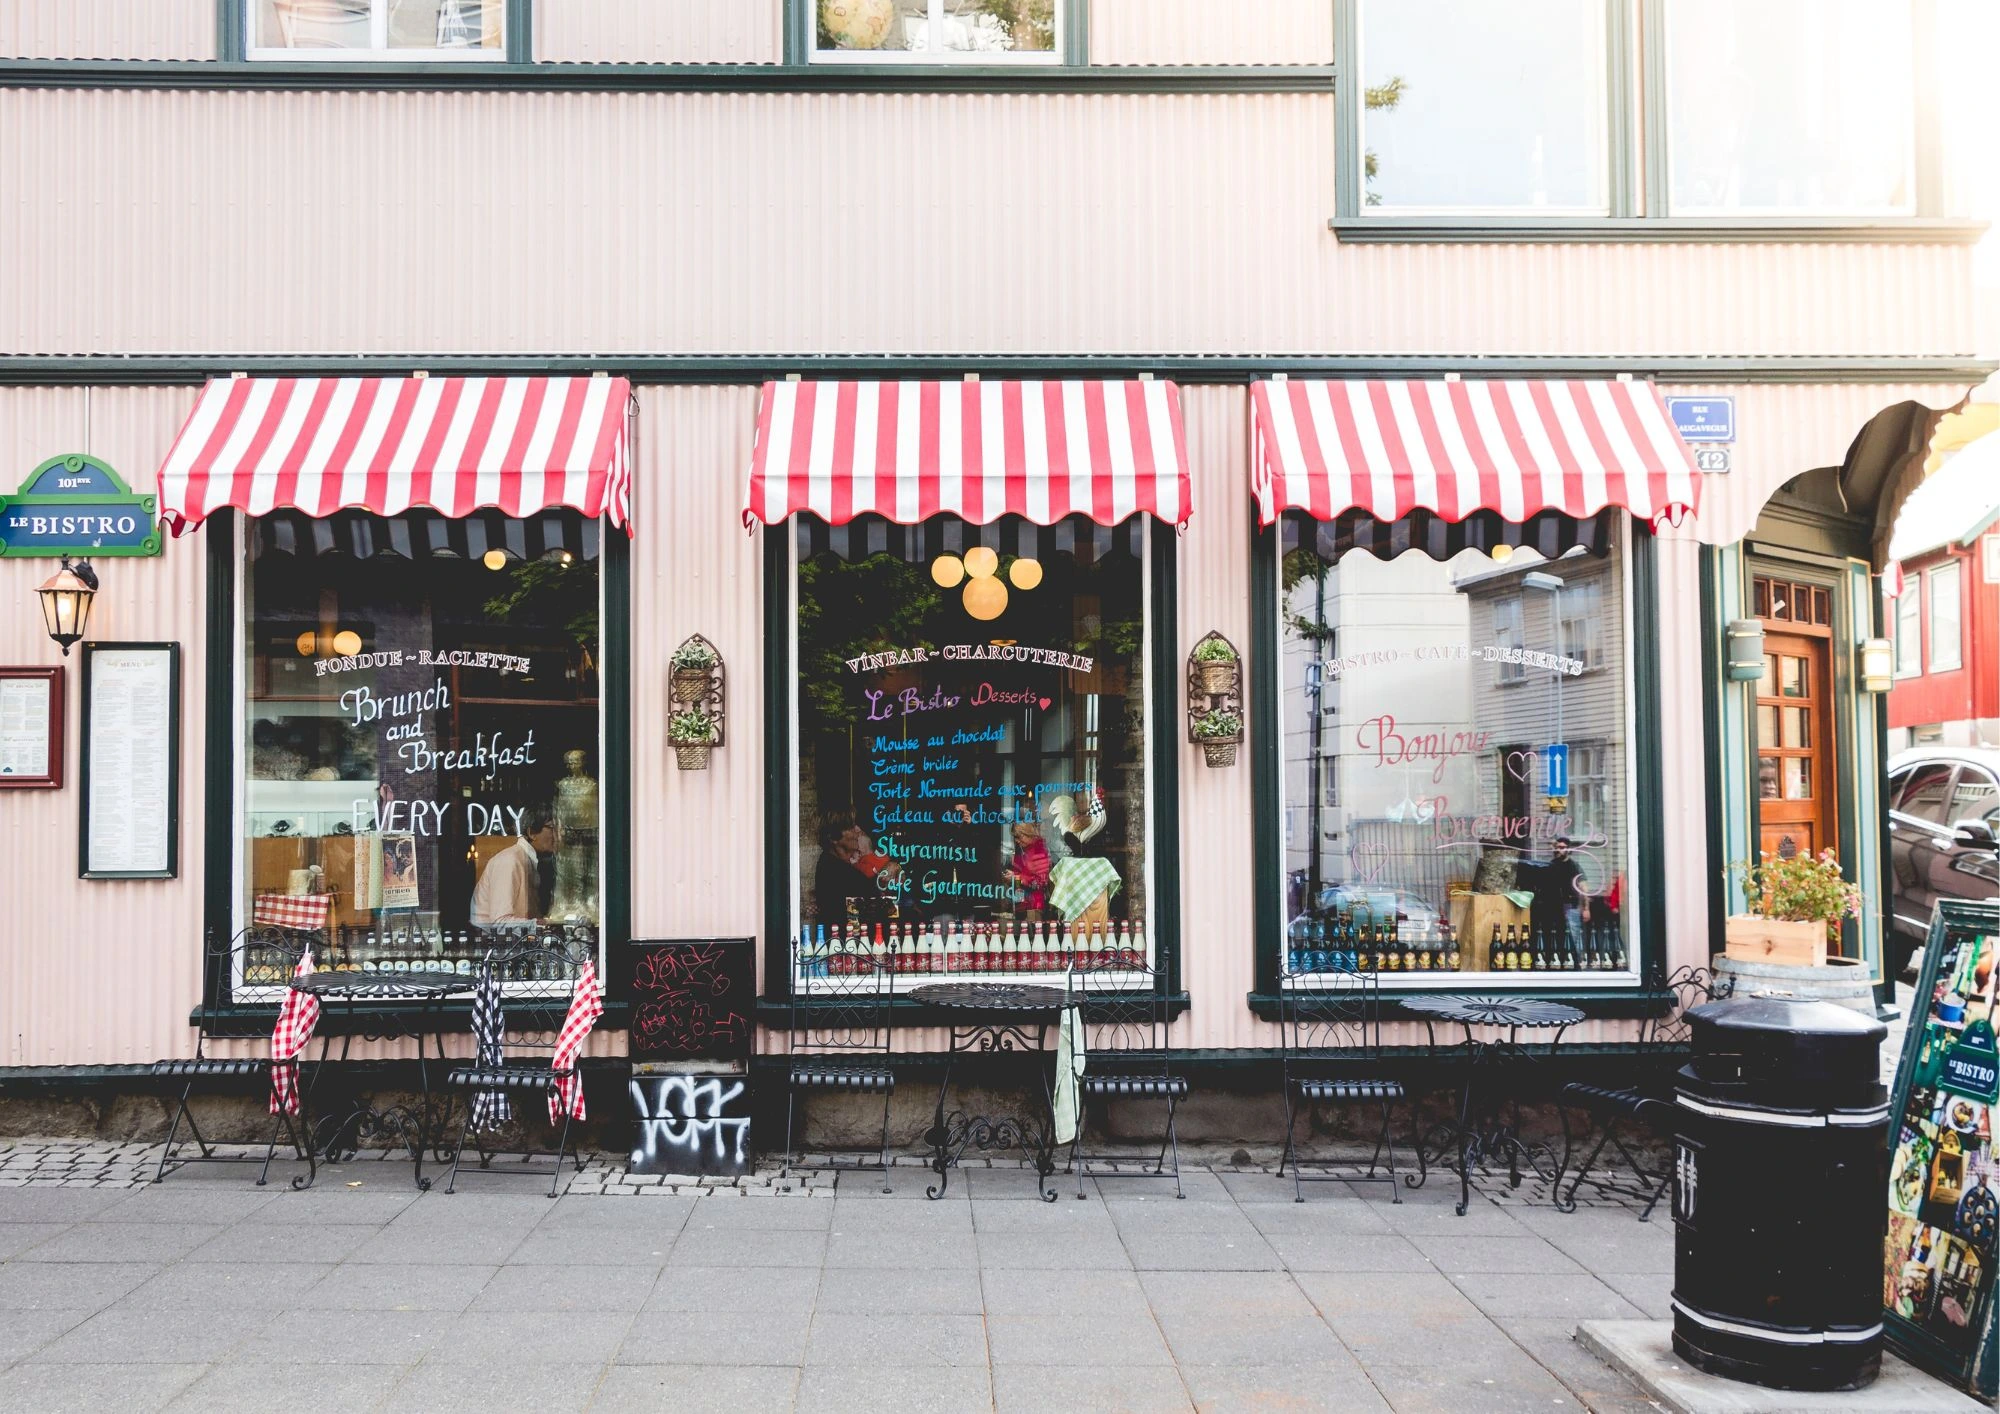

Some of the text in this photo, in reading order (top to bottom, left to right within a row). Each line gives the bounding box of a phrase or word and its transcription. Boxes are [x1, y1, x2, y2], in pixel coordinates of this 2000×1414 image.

[1678, 424, 1728, 432] AUGAVEGUR
[1701, 452, 1725, 469] 12
[9, 516, 136, 535] LE BISTRO
[313, 649, 403, 677] FONDUE
[418, 649, 531, 674] RACLETTE
[845, 646, 929, 674] VÍNBAR
[943, 644, 1094, 674] CHARCUTERIE
[1325, 649, 1399, 676] BISTRO
[1483, 645, 1584, 676] DESSERTS
[340, 677, 451, 727] Brunch
[864, 681, 1037, 721] Le Bistro Desserts
[385, 713, 425, 741] and
[871, 722, 1006, 753] Mousse au chocolat
[398, 729, 537, 780] Breakfast
[1356, 714, 1494, 784] Bonjour
[870, 759, 916, 776] Crème
[917, 778, 992, 799] Normande
[997, 783, 1027, 796] aux
[352, 798, 526, 838] EVERY DAY
[871, 800, 1042, 833] Gateau au chocolat
[1418, 795, 1574, 841] Bienvenue
[874, 835, 978, 865] Skyramisu
[875, 869, 913, 904] Café
[1955, 1060, 1995, 1083] BISTRO
